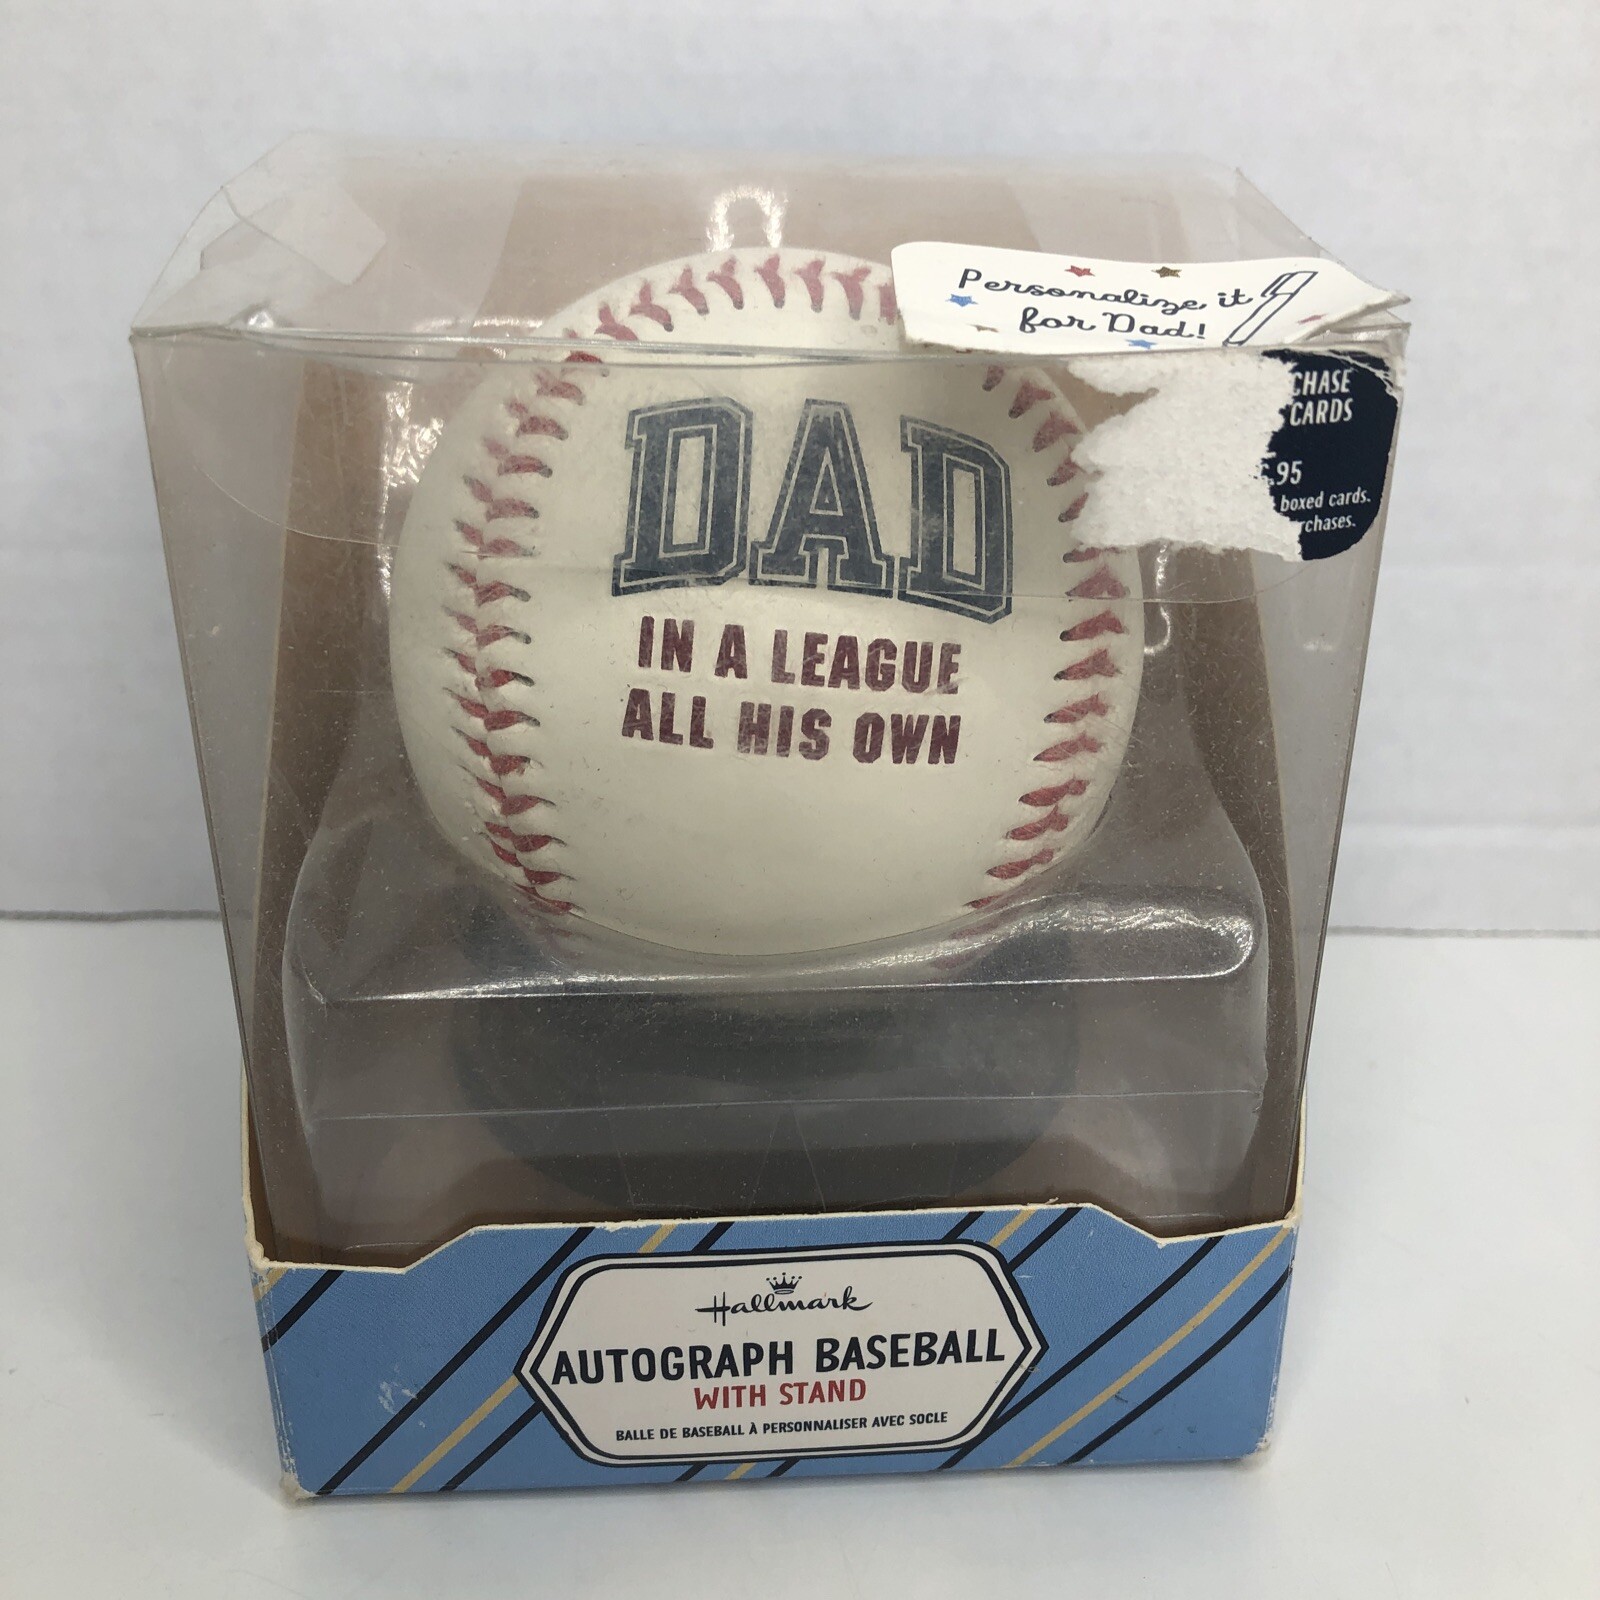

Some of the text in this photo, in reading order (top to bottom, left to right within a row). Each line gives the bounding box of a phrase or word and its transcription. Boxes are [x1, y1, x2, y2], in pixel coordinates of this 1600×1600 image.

[958, 268, 1253, 315] Personalize it
[1018, 307, 1206, 339] for Dad!
[1289, 398, 1354, 426] CARDS
[612, 396, 1014, 624] DAD
[1280, 487, 1371, 512] boxed cards.
[638, 615, 962, 695] IN A LEAGUE
[621, 688, 961, 765] ALL HIS OWN
[695, 1285, 873, 1326] Hallmark
[551, 1328, 1005, 1385] AUTOGRAPH BASEBALL
[694, 1378, 866, 1410] WITH STAND
[616, 1411, 948, 1441] BALLE DE BASEBALL À PERSONNALISER AVEC SOCLE
